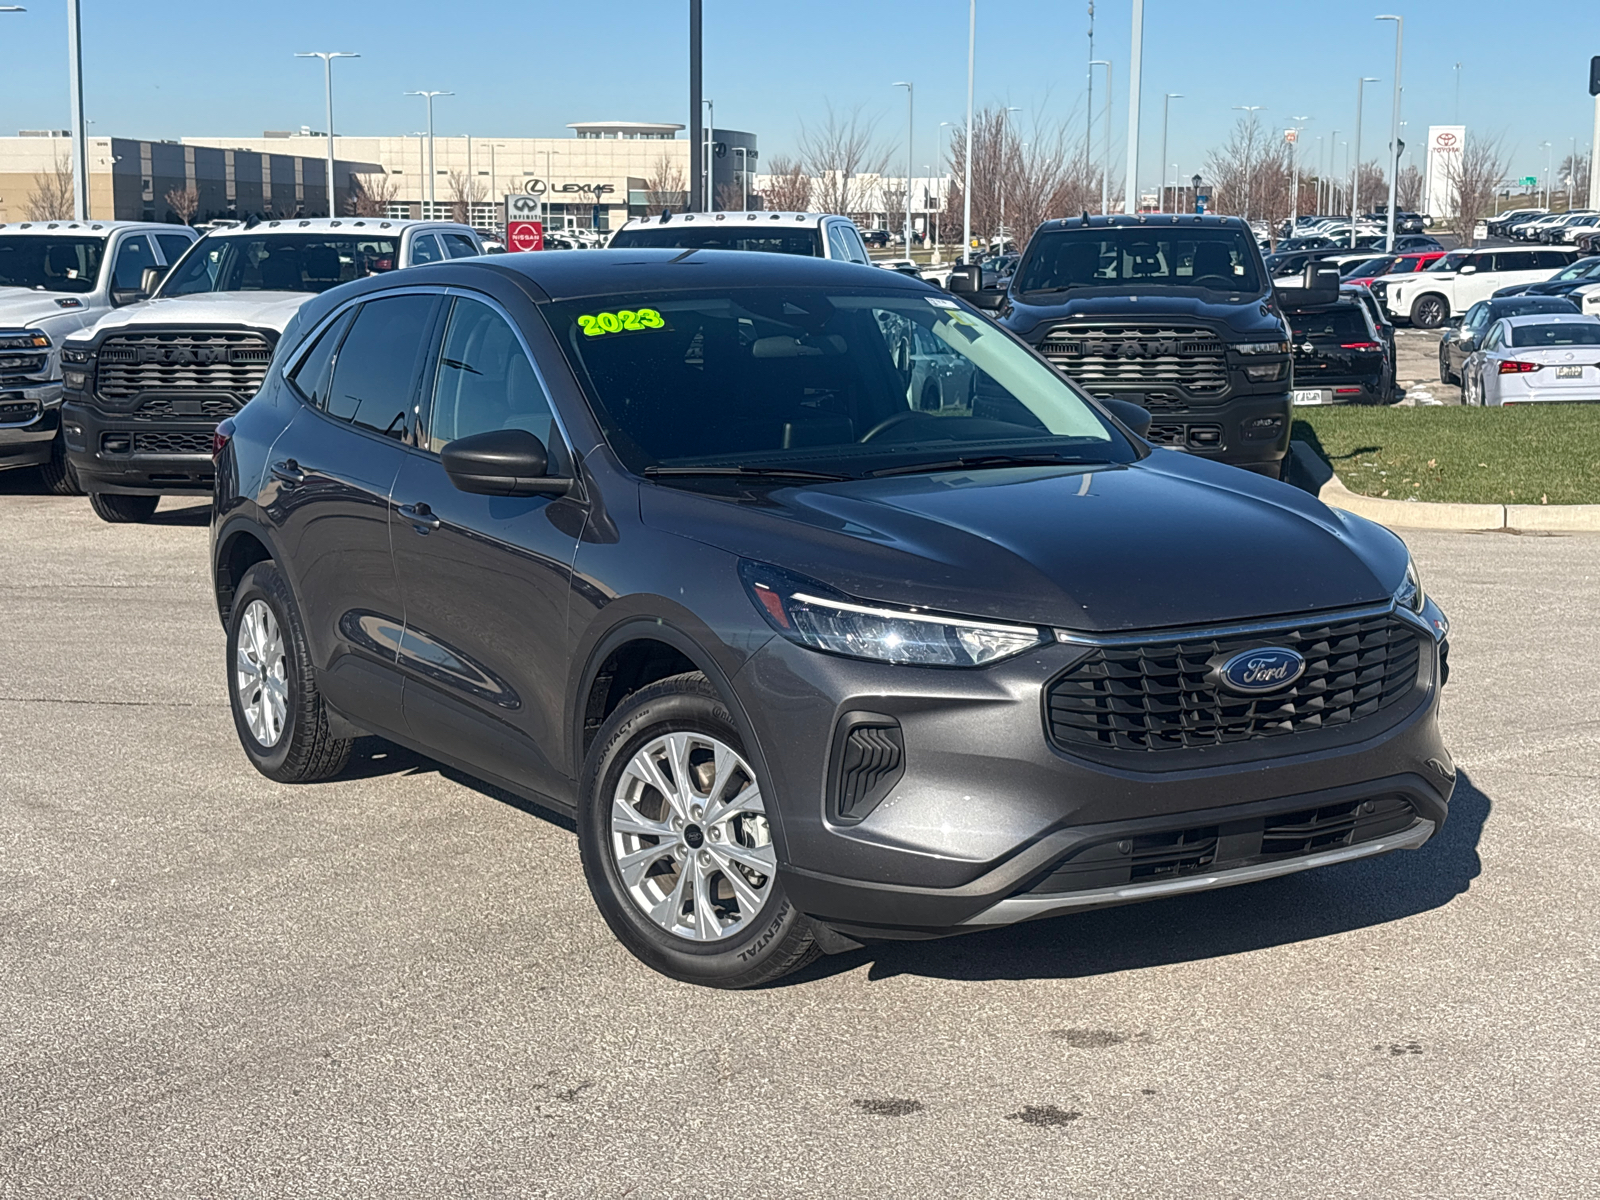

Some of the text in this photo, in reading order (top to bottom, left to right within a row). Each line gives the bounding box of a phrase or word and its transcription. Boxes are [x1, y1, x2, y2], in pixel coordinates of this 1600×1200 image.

[551, 183, 615, 193] LEXUS
[577, 308, 665, 337] 2023
[140, 348, 227, 362] RAM
[1083, 340, 1178, 356] RAM
[1243, 656, 1288, 683] Ford
